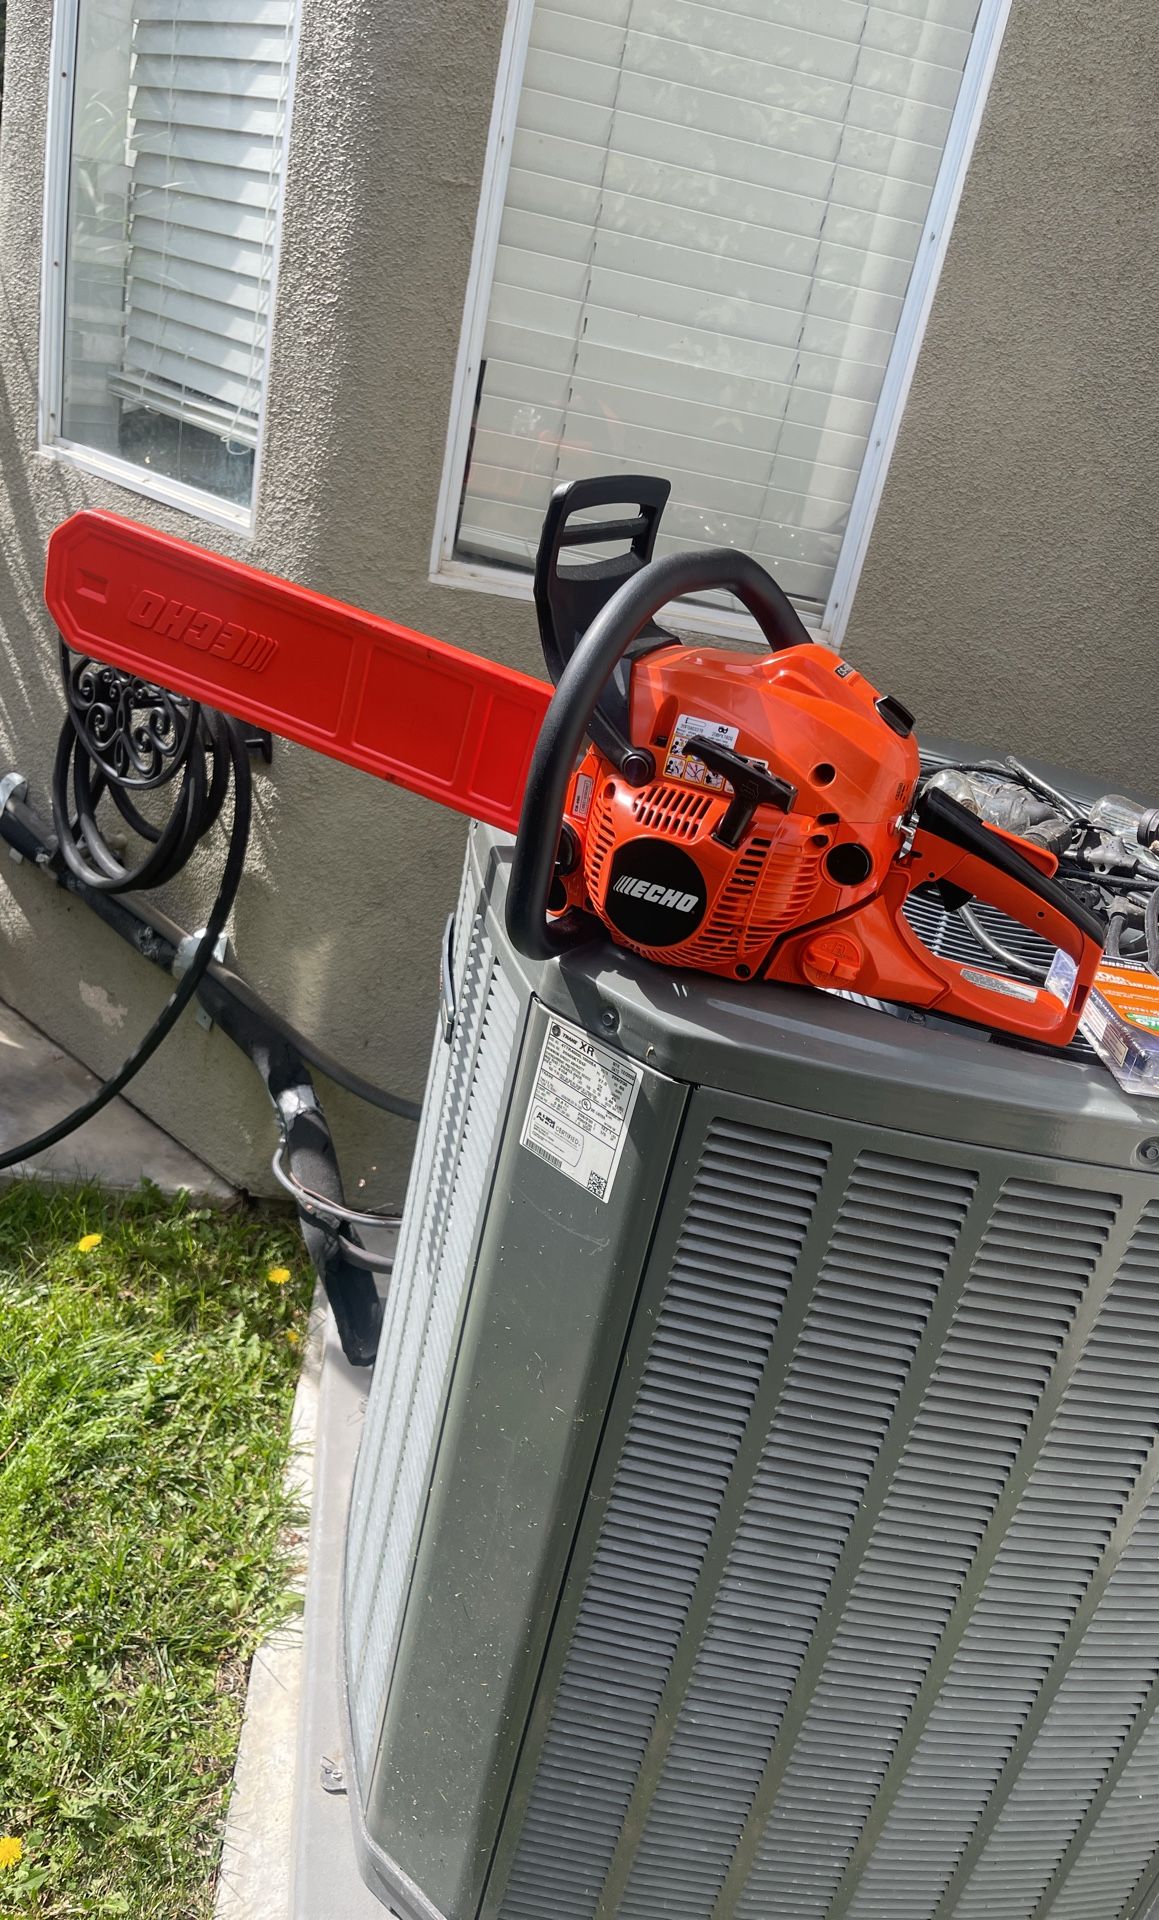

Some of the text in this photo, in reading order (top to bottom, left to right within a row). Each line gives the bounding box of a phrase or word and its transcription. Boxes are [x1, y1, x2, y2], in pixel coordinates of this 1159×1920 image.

[127, 589, 248, 660] ECHO
[629, 879, 699, 913] ECHO
[562, 1033, 577, 1045] TRANE
[579, 1041, 595, 1057] XR
[555, 1126, 579, 1145] CERTIFIED
